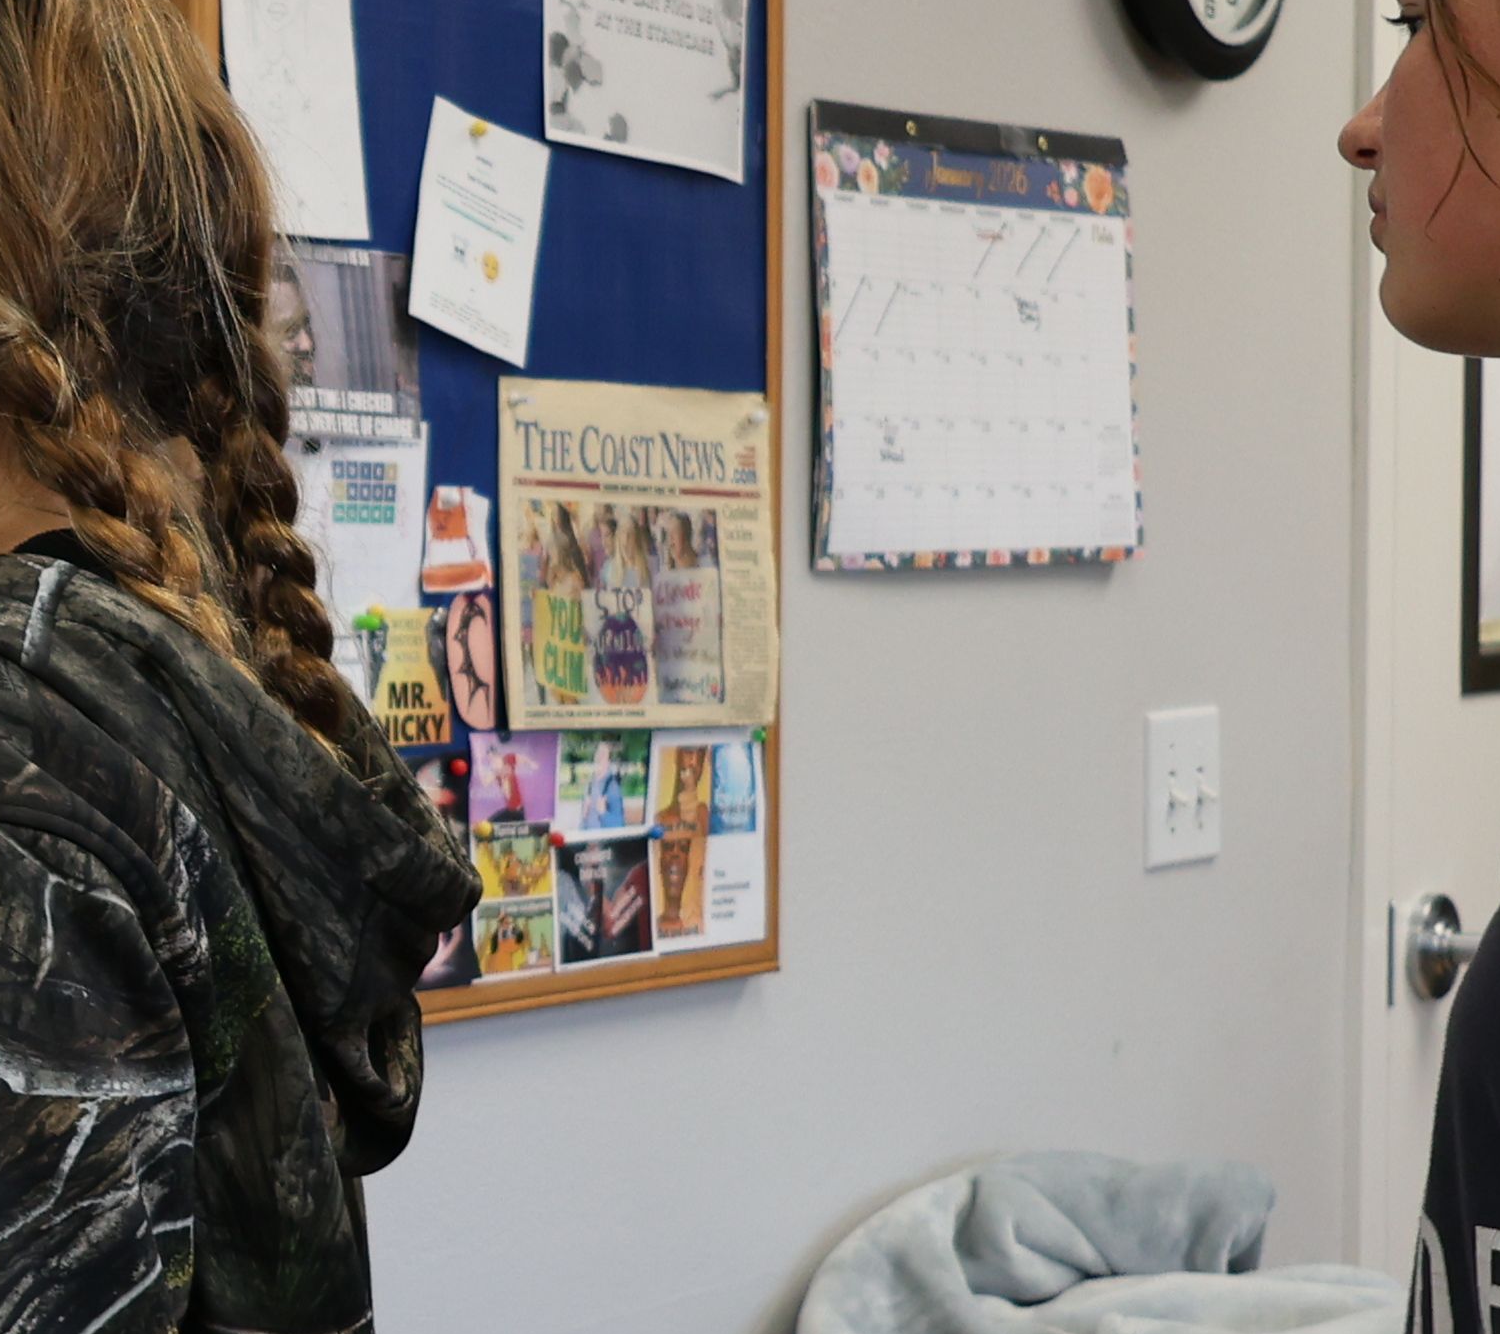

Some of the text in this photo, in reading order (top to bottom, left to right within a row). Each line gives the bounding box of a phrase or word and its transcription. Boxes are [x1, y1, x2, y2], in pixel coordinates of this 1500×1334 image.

[515, 418, 574, 473] THE
[579, 424, 655, 479] COAST
[659, 431, 726, 484] NEWS
[387, 681, 433, 710] MR.
